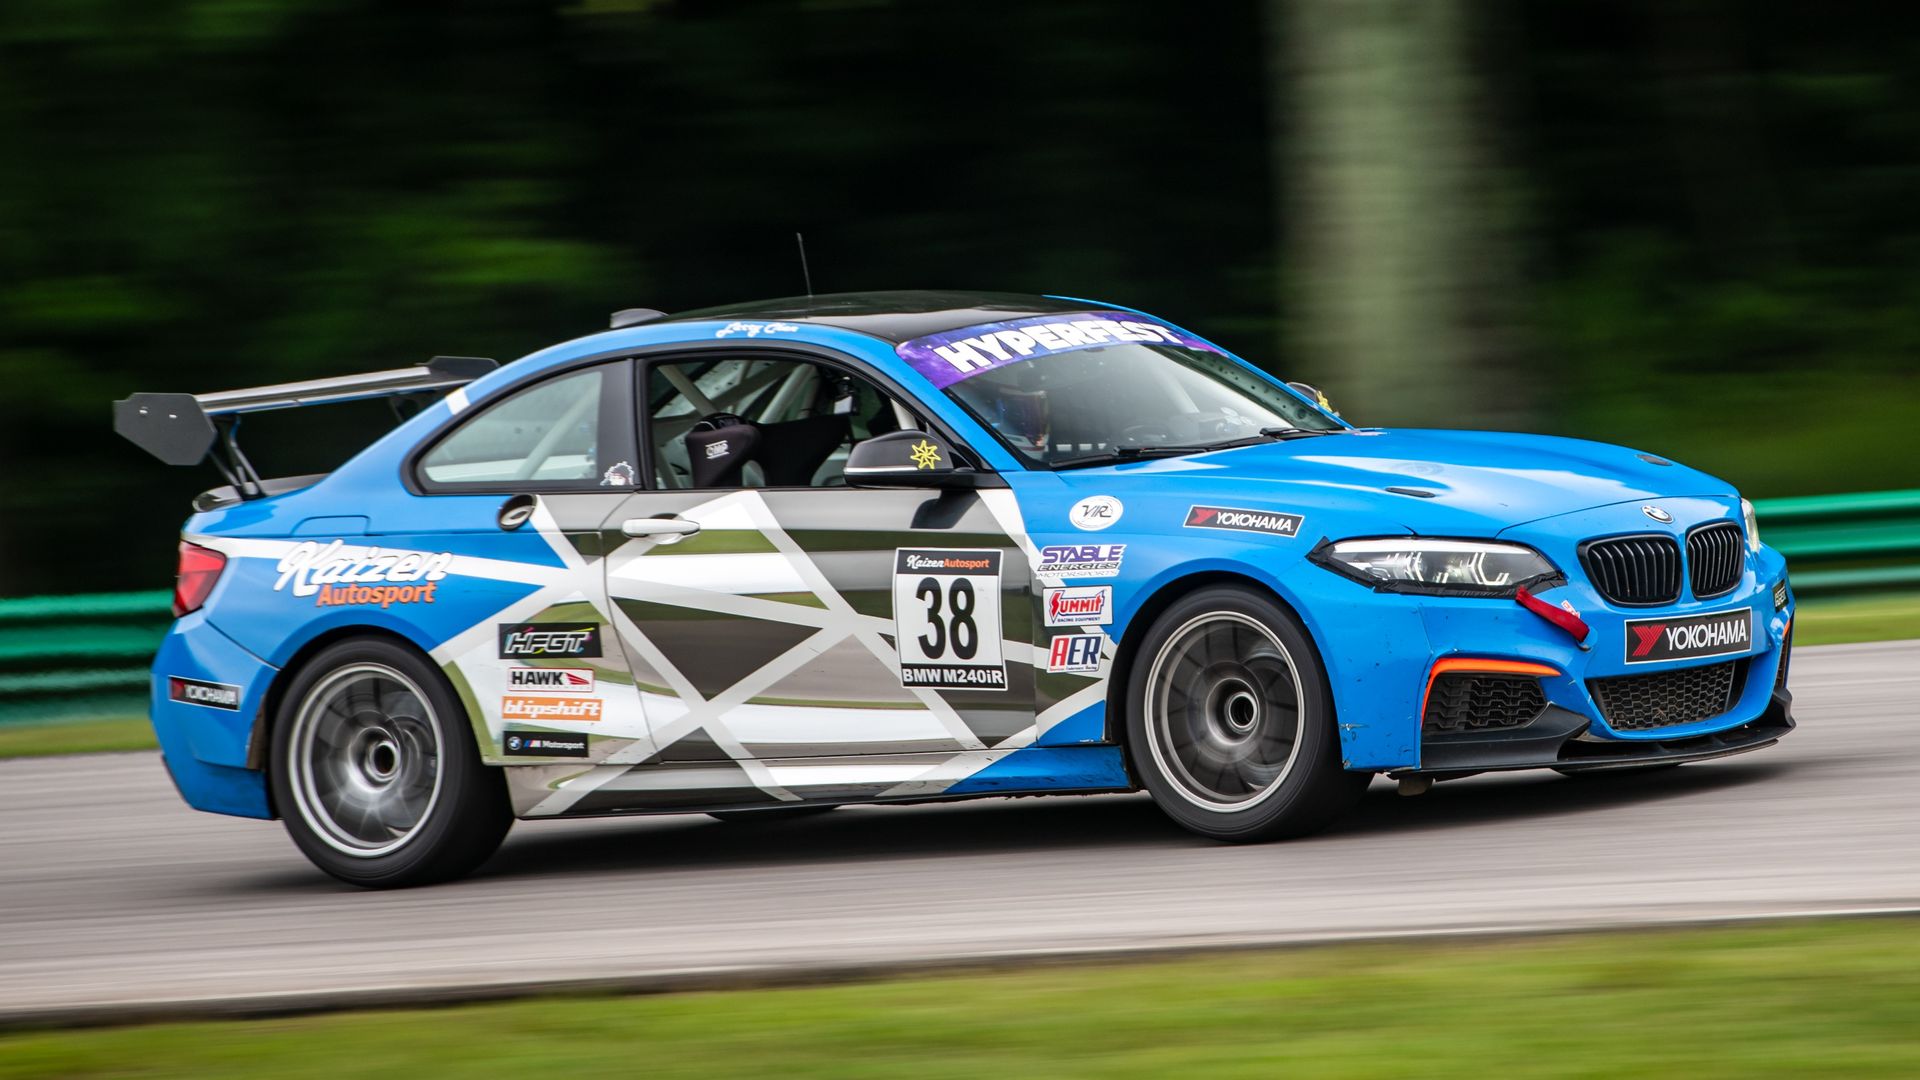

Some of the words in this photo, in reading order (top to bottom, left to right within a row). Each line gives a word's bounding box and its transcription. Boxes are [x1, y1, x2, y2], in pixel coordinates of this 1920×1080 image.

[933, 320, 1183, 373] HYPERFEST
[1082, 505, 1112, 518] VIR
[1216, 511, 1292, 532] YOKOHAMA
[1042, 546, 1124, 564] STABLE
[273, 538, 454, 597] Kaizen
[1038, 562, 1119, 571] ENERGIES
[316, 580, 438, 609] Autosport
[916, 577, 978, 660] 38
[1666, 618, 1748, 651] YOKOHAMA
[1050, 636, 1102, 667] AER
[512, 671, 563, 685] HAWK
[903, 668, 940, 683] BMW
[944, 669, 1004, 684] M240iR
[504, 699, 600, 718] blipshift
[542, 740, 585, 750] Motorsport
